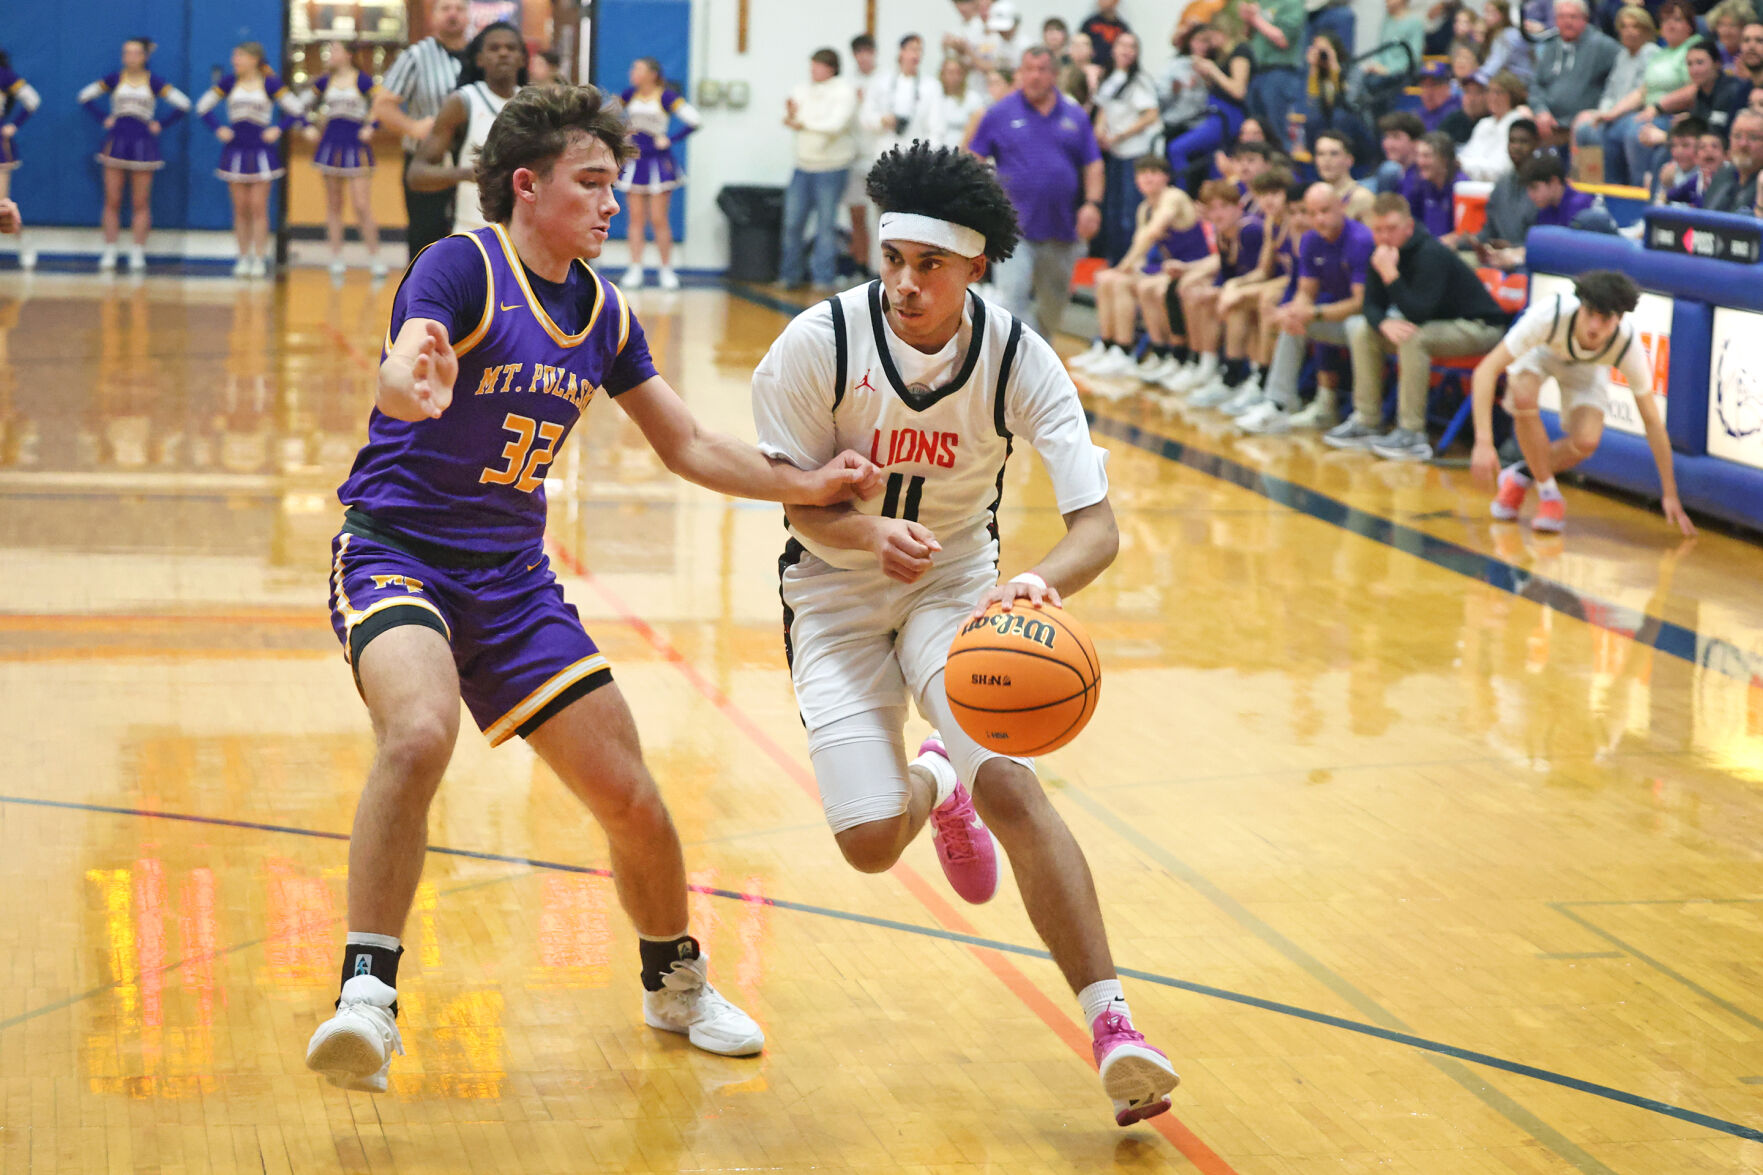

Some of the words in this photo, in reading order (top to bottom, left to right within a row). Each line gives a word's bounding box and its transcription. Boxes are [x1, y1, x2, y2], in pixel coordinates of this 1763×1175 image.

[475, 363, 522, 395] MT.
[479, 413, 565, 494] 32
[871, 428, 959, 468] LIONS
[881, 473, 926, 522] 11
[961, 612, 1056, 649] Wilson
